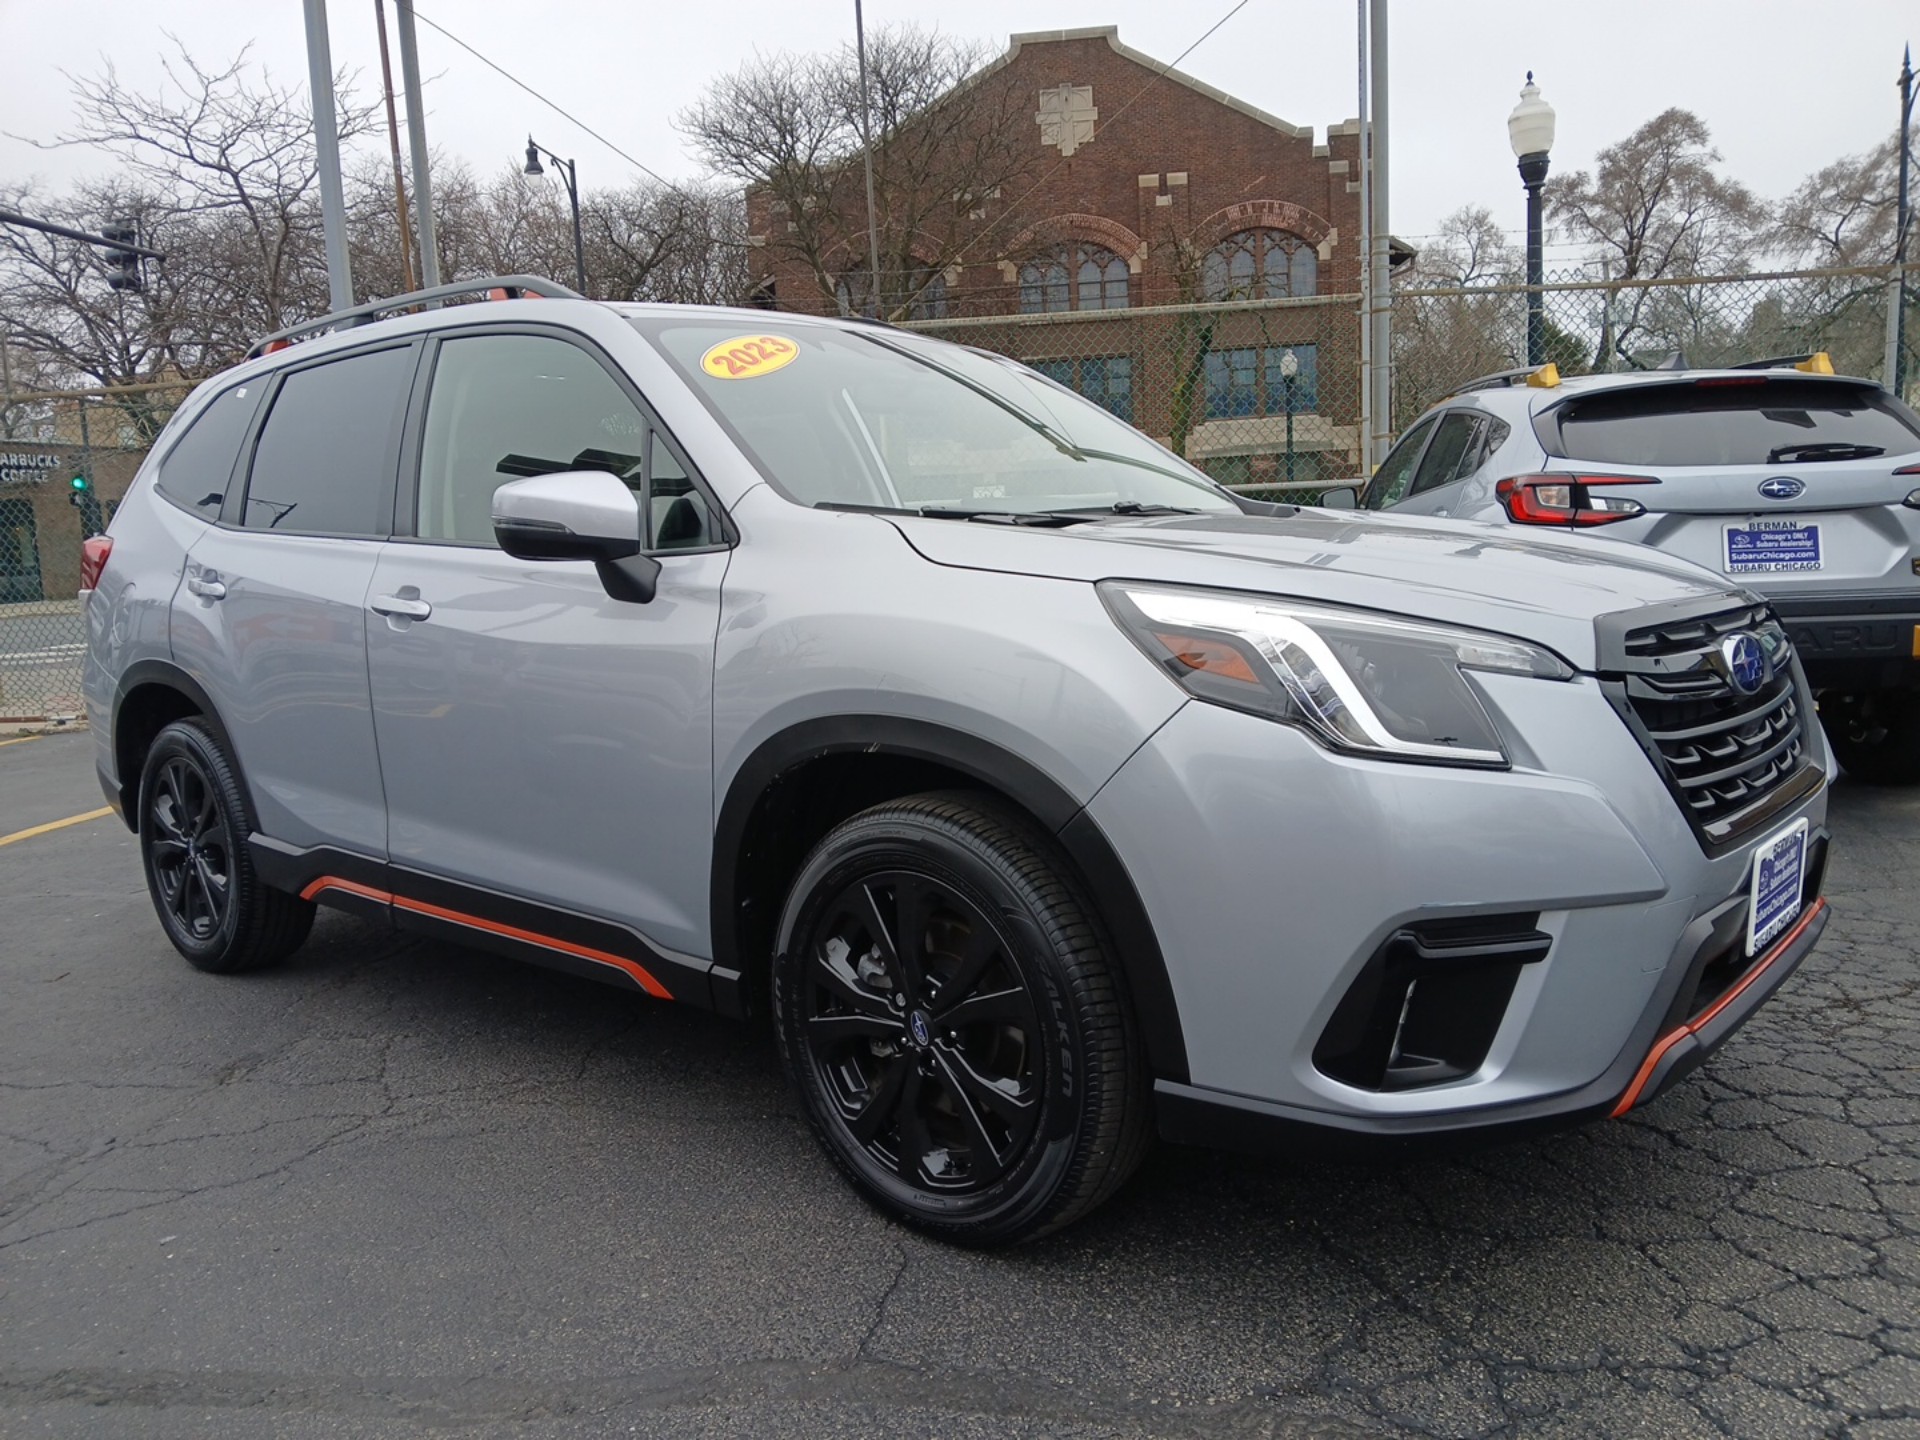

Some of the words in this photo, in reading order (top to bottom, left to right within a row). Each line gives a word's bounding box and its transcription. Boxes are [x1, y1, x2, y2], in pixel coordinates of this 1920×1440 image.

[712, 336, 792, 375] 2023
[1748, 521, 1797, 530] BERMAN
[1792, 532, 1809, 540] ONLY
[1731, 551, 1815, 561] SubaruChicago.com
[1730, 563, 1772, 572] SUBARU
[1774, 562, 1821, 571] CHICAGO
